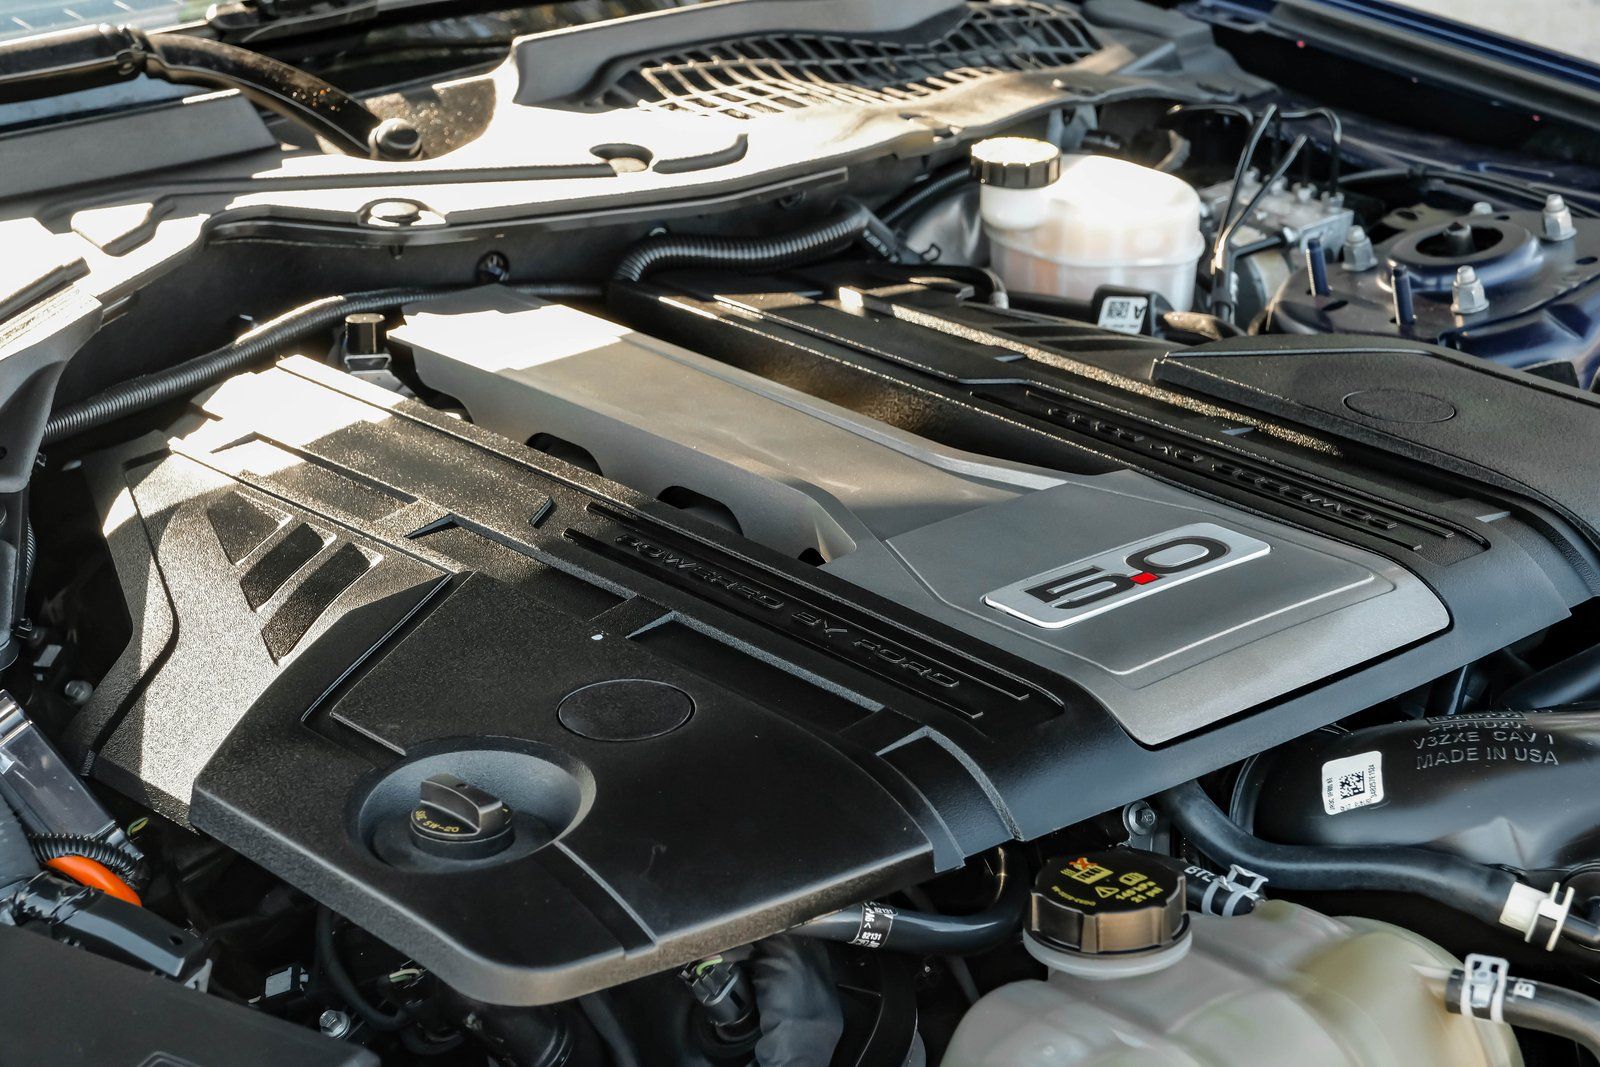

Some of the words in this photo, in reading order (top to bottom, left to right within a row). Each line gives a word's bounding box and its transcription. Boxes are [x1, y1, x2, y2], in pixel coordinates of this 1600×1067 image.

[1023, 535, 1231, 609] 5.0
[614, 533, 785, 609] POWERED
[791, 609, 848, 635] BY
[852, 637, 960, 688] FORD
[1415, 747, 1480, 770] MADE
[1486, 746, 1507, 760] IN
[1514, 747, 1560, 766] USA
[422, 820, 460, 833] 5W-20
